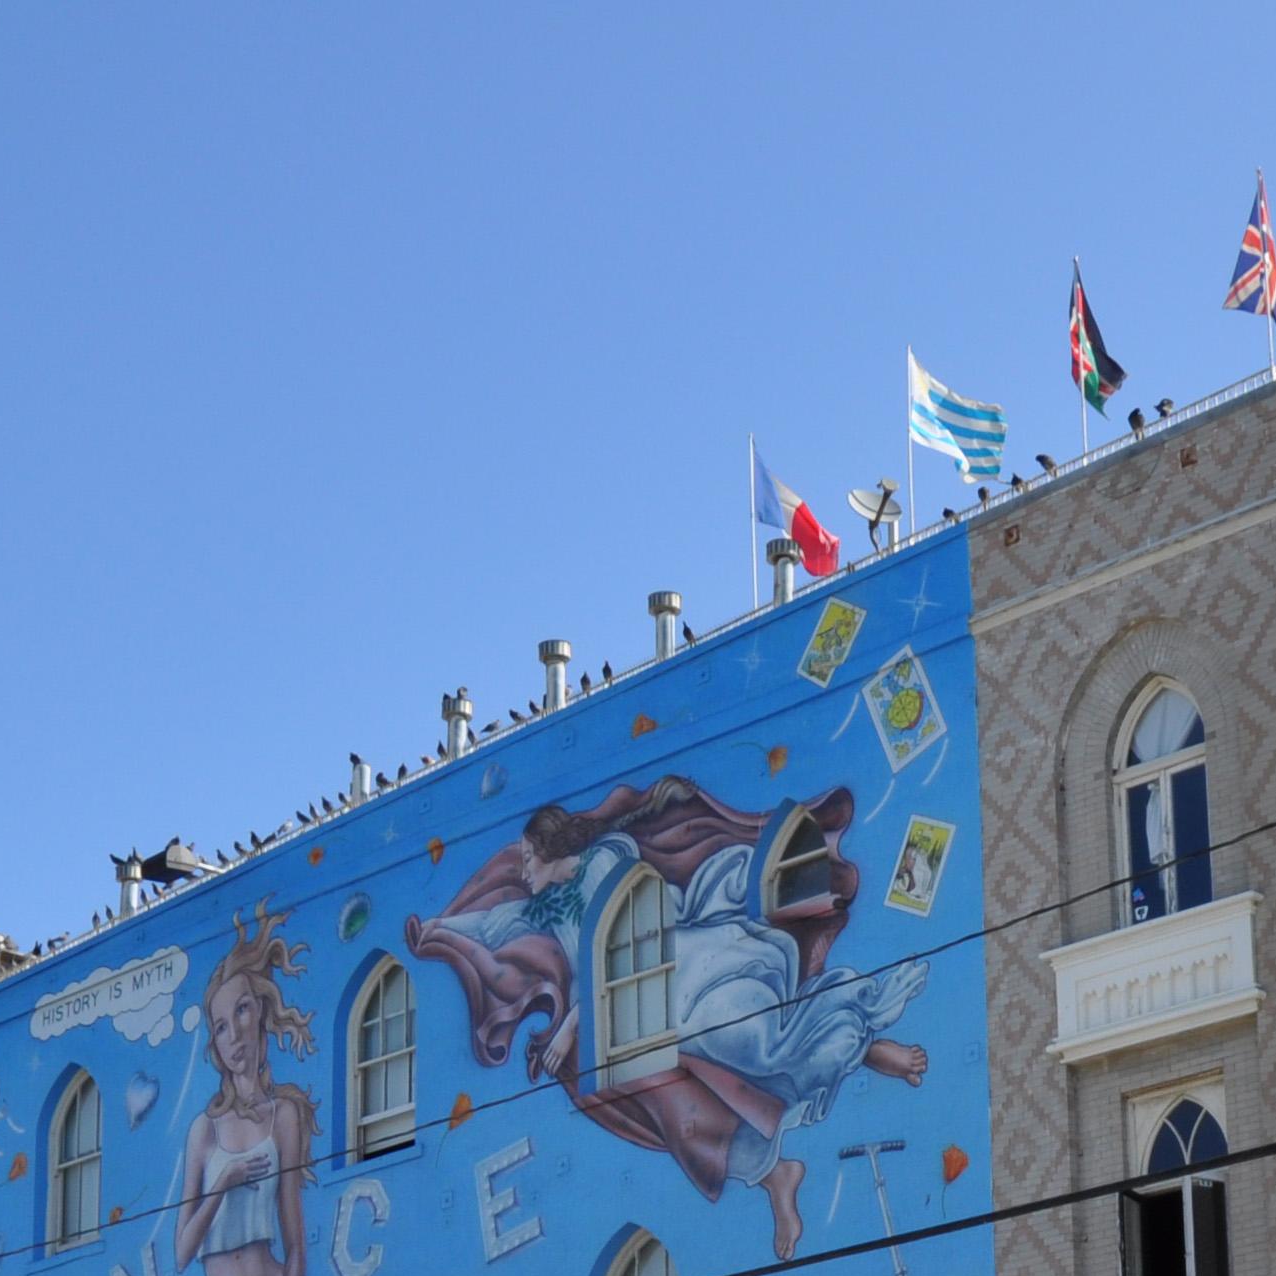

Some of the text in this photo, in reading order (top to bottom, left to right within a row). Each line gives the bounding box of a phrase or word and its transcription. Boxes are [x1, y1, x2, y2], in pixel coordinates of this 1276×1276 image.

[41, 960, 174, 1027] HISTORY IS MYTH
